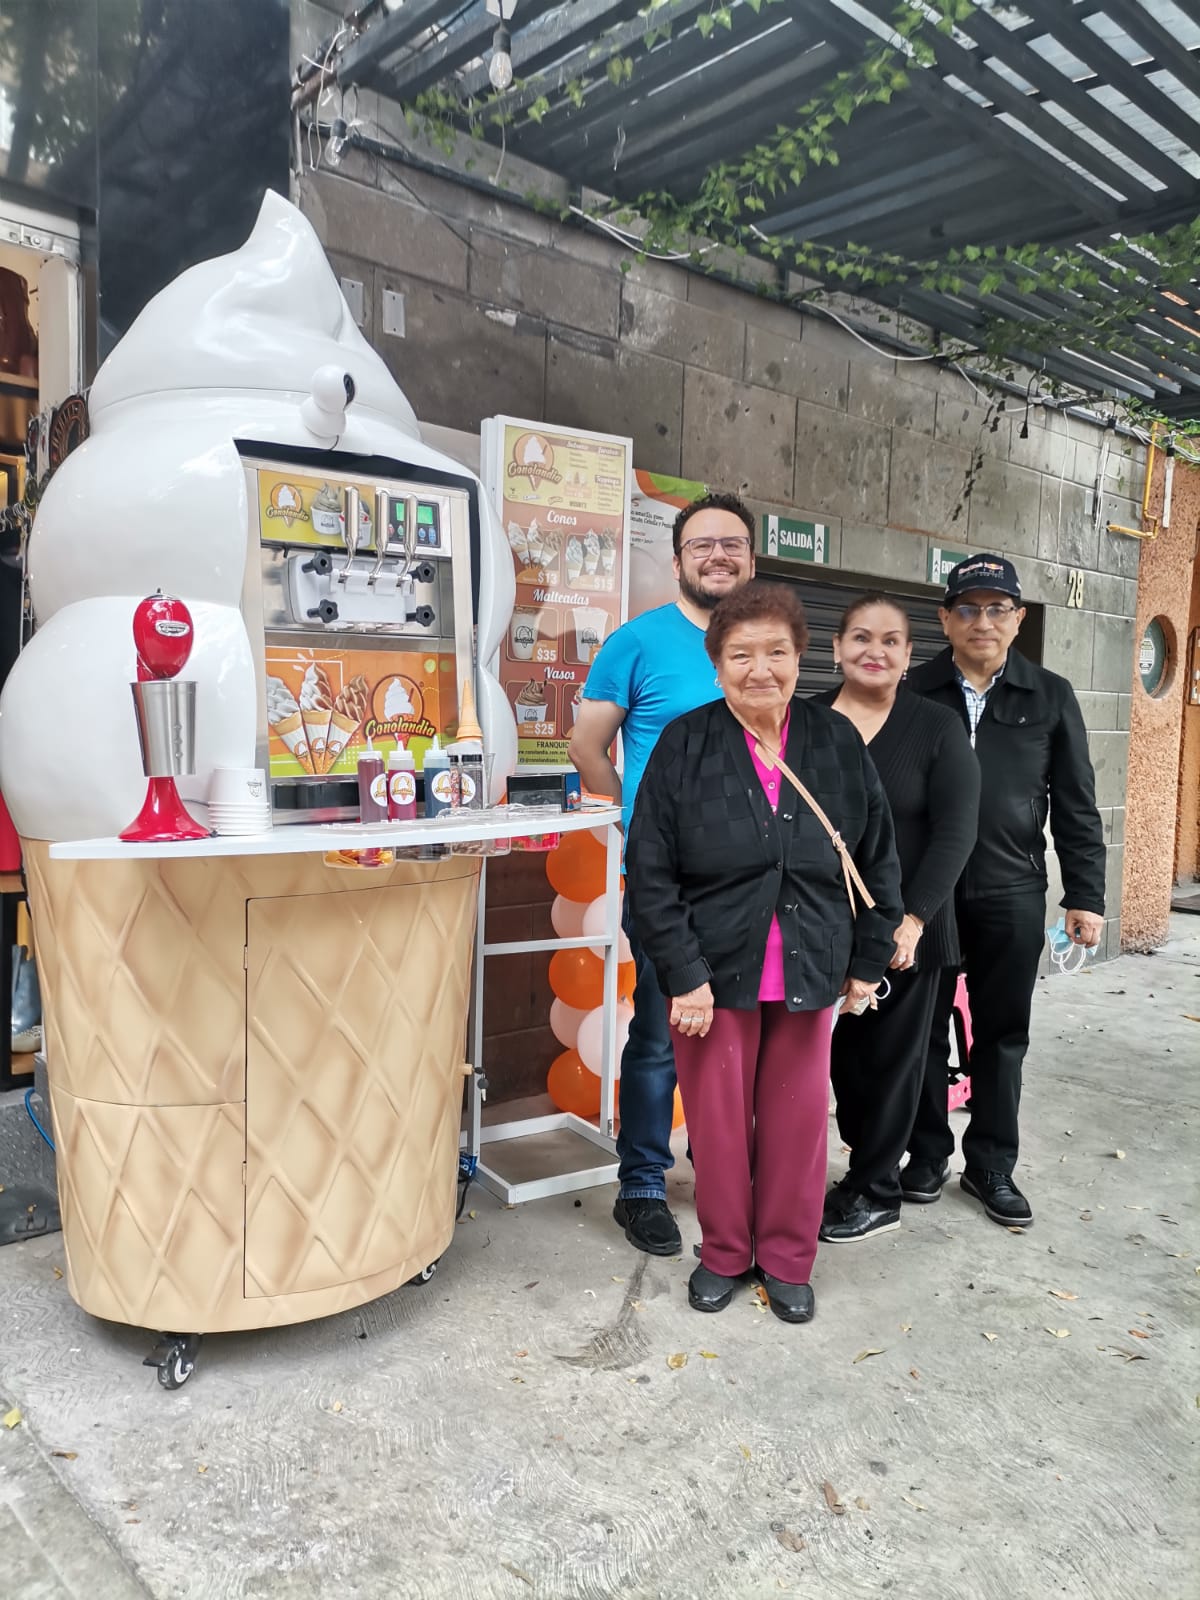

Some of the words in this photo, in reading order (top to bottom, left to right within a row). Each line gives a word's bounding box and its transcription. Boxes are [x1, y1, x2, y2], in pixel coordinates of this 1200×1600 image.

[508, 462, 562, 483] Conolandia
[266, 506, 310, 521] Conolandia
[547, 510, 577, 526] Conos
[780, 529, 813, 550] SALIDA
[537, 571, 557, 585] $13
[594, 577, 613, 590] $15
[1067, 570, 1084, 608] 28
[537, 648, 557, 661] $35
[544, 666, 575, 680] Vasos
[364, 717, 436, 738] Conolandia
[534, 723, 554, 735] $25
[536, 741, 570, 749] FRANQUIC
